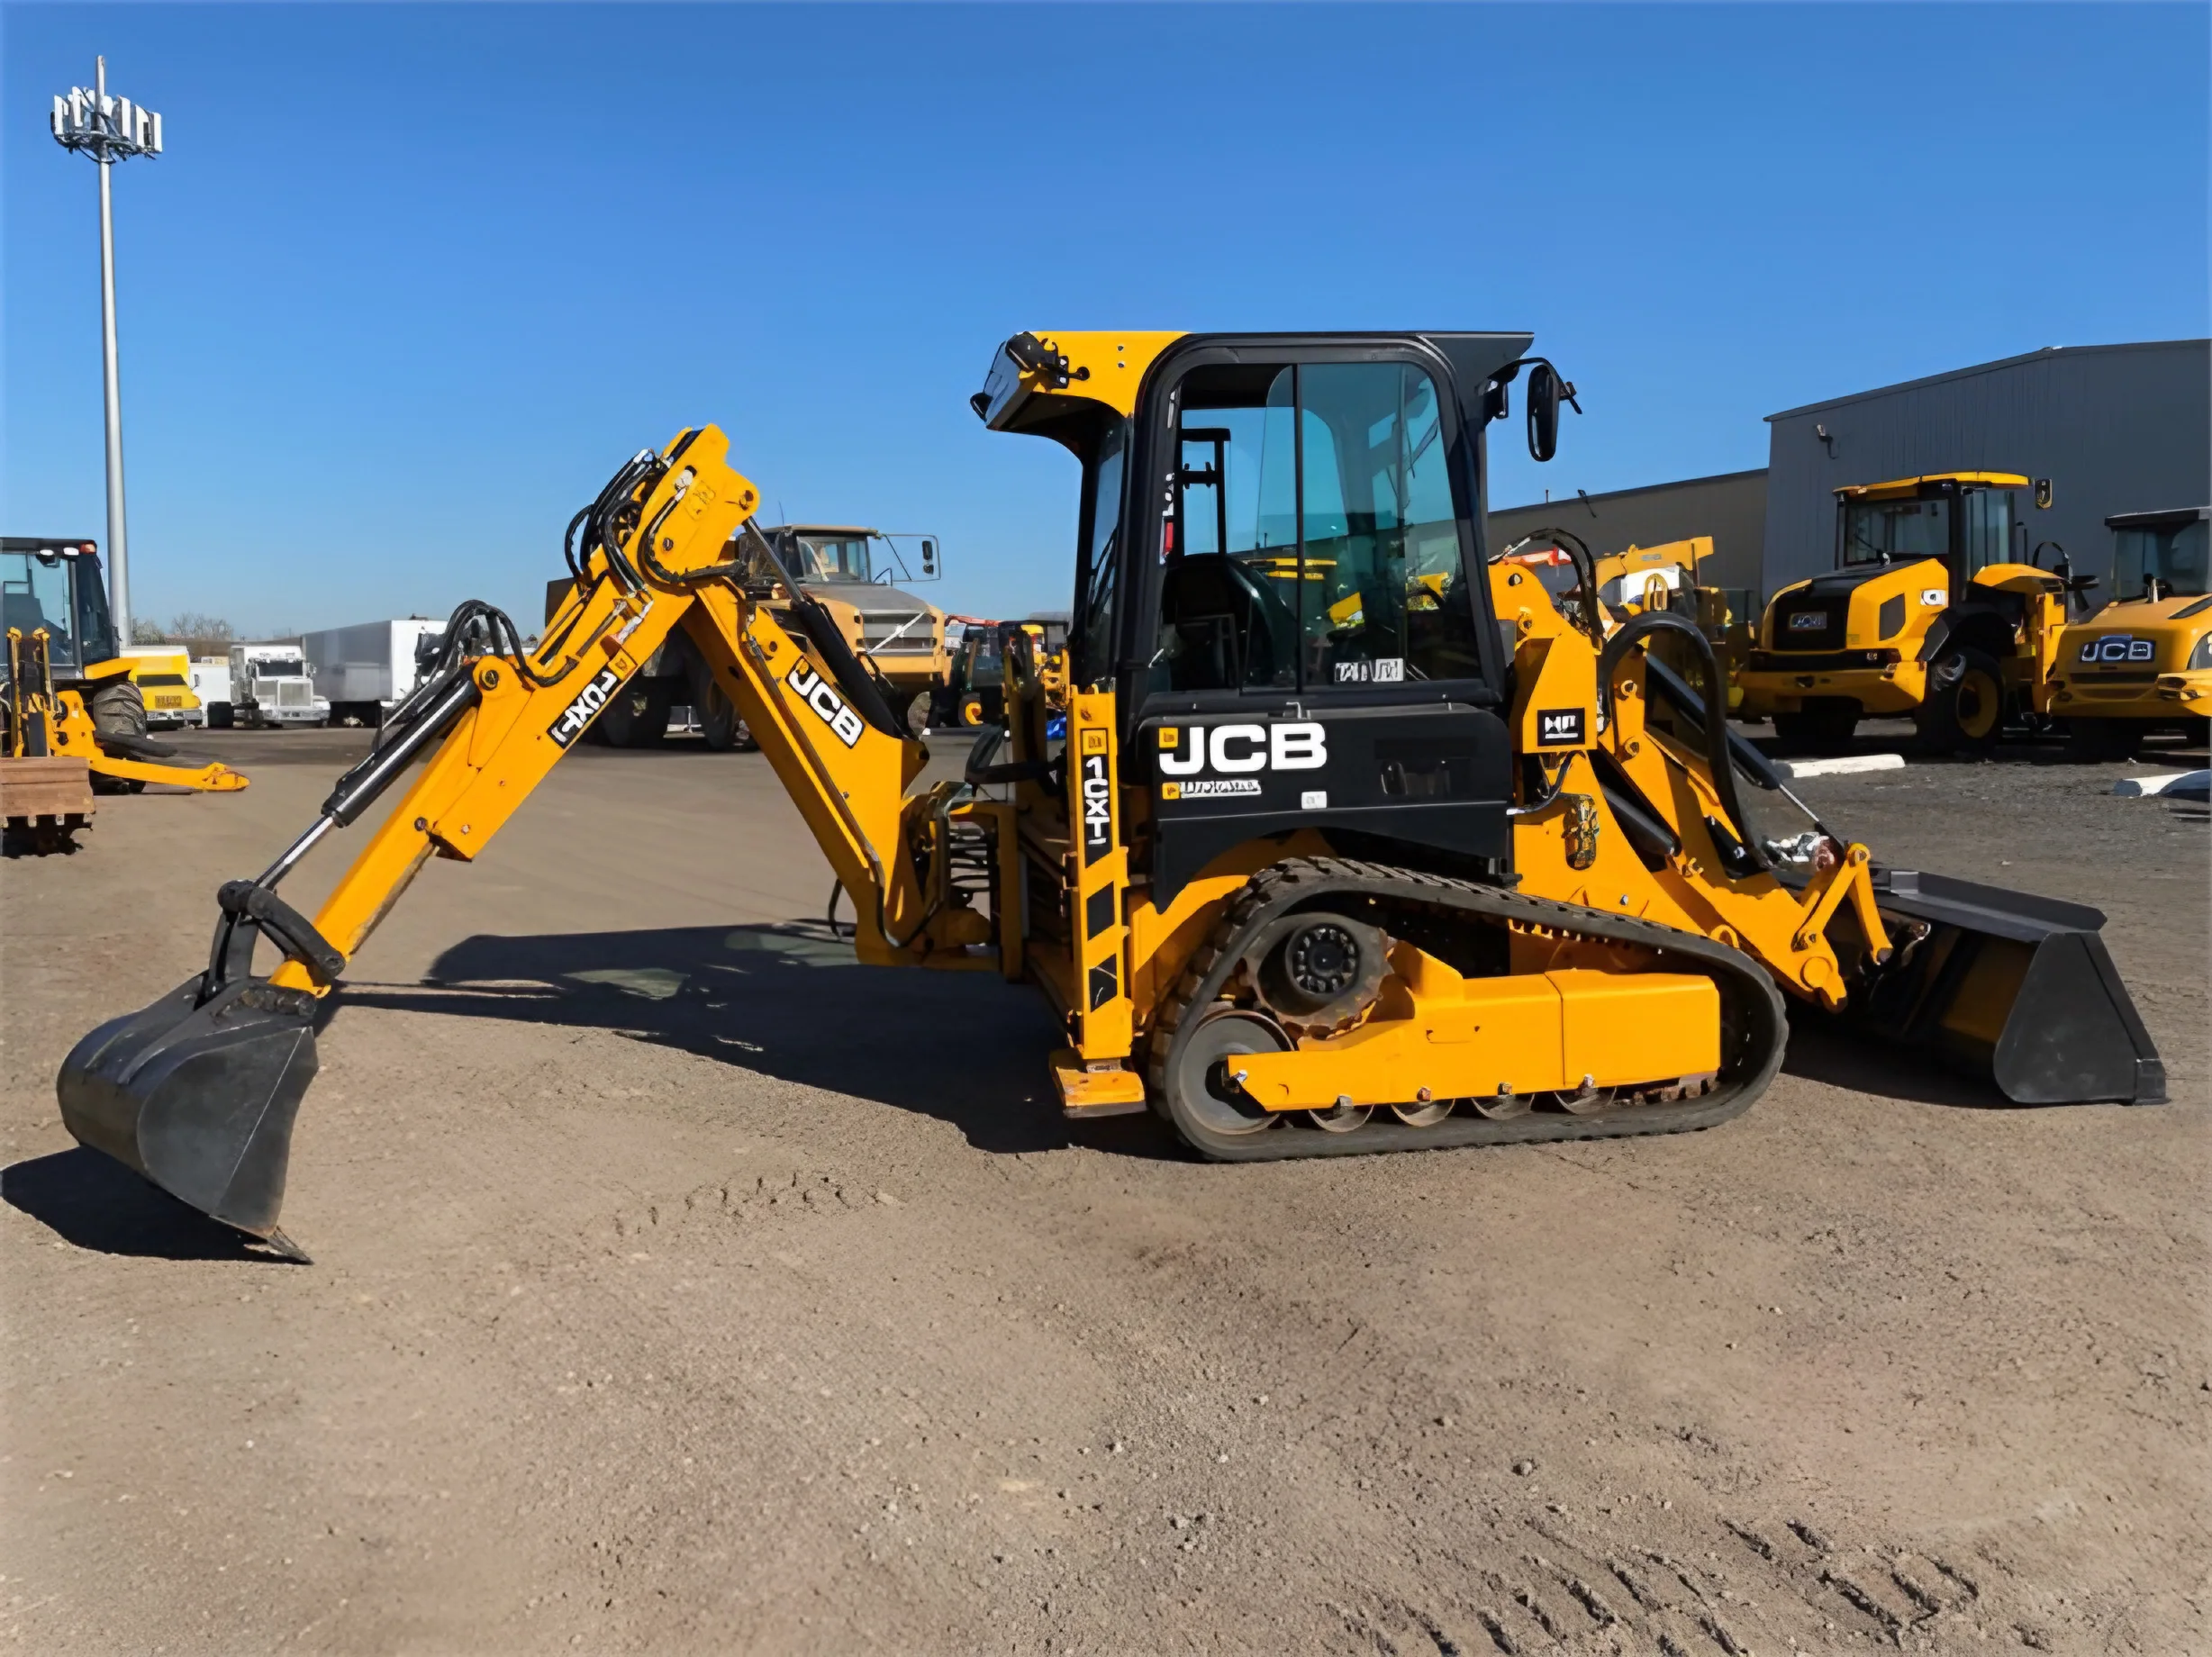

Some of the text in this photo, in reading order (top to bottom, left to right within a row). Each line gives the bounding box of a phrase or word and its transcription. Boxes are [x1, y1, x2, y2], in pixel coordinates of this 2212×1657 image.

[553, 671, 618, 740] 1CXT
[788, 667, 864, 748] JCB
[1159, 722, 1328, 774] JCB
[1083, 756, 1111, 842] 1CXT
